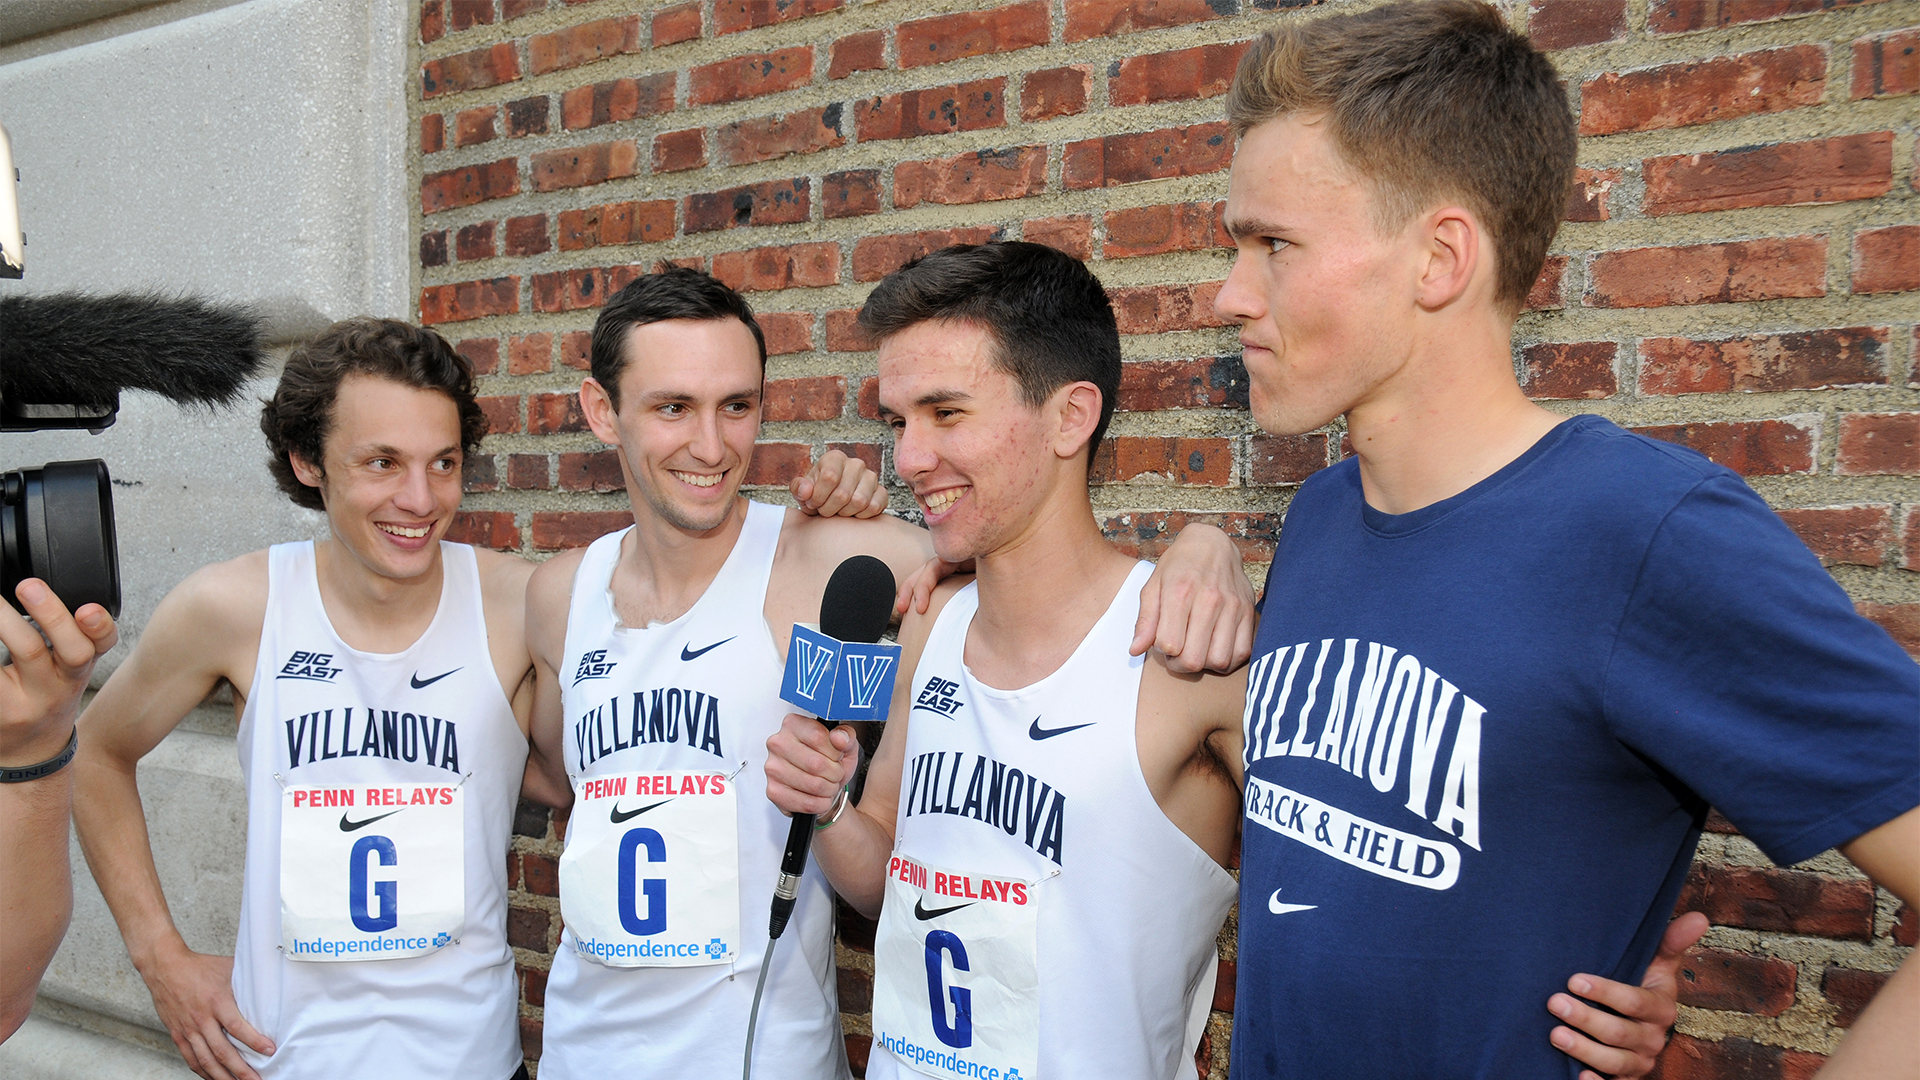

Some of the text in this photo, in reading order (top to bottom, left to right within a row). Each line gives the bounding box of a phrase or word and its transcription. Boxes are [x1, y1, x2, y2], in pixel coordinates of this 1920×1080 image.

[280, 663, 343, 679] EAST
[289, 651, 333, 666] BIG
[575, 662, 618, 680] EAST
[580, 649, 607, 666] BIG
[795, 636, 834, 700] V
[845, 654, 894, 708] V
[916, 690, 965, 714] EAST
[925, 676, 960, 697] BIG
[285, 707, 460, 774] VILLANOVA
[575, 687, 724, 771] VILLANOVA
[1242, 638, 1488, 852] VILLANOVA
[9, 764, 51, 779] ONE
[584, 775, 725, 801] PENN RELAYS
[293, 787, 453, 808] PENN RELAYS
[906, 751, 1066, 867] VILLANOVA
[1247, 781, 1446, 879] TRACK & FIELD
[349, 835, 398, 933] G
[617, 827, 667, 936] G
[889, 857, 1028, 906] PENN RELAYS
[294, 936, 427, 957] Independence
[575, 937, 699, 960] Independence
[924, 929, 972, 1049] G
[882, 1031, 999, 1080] Independence
